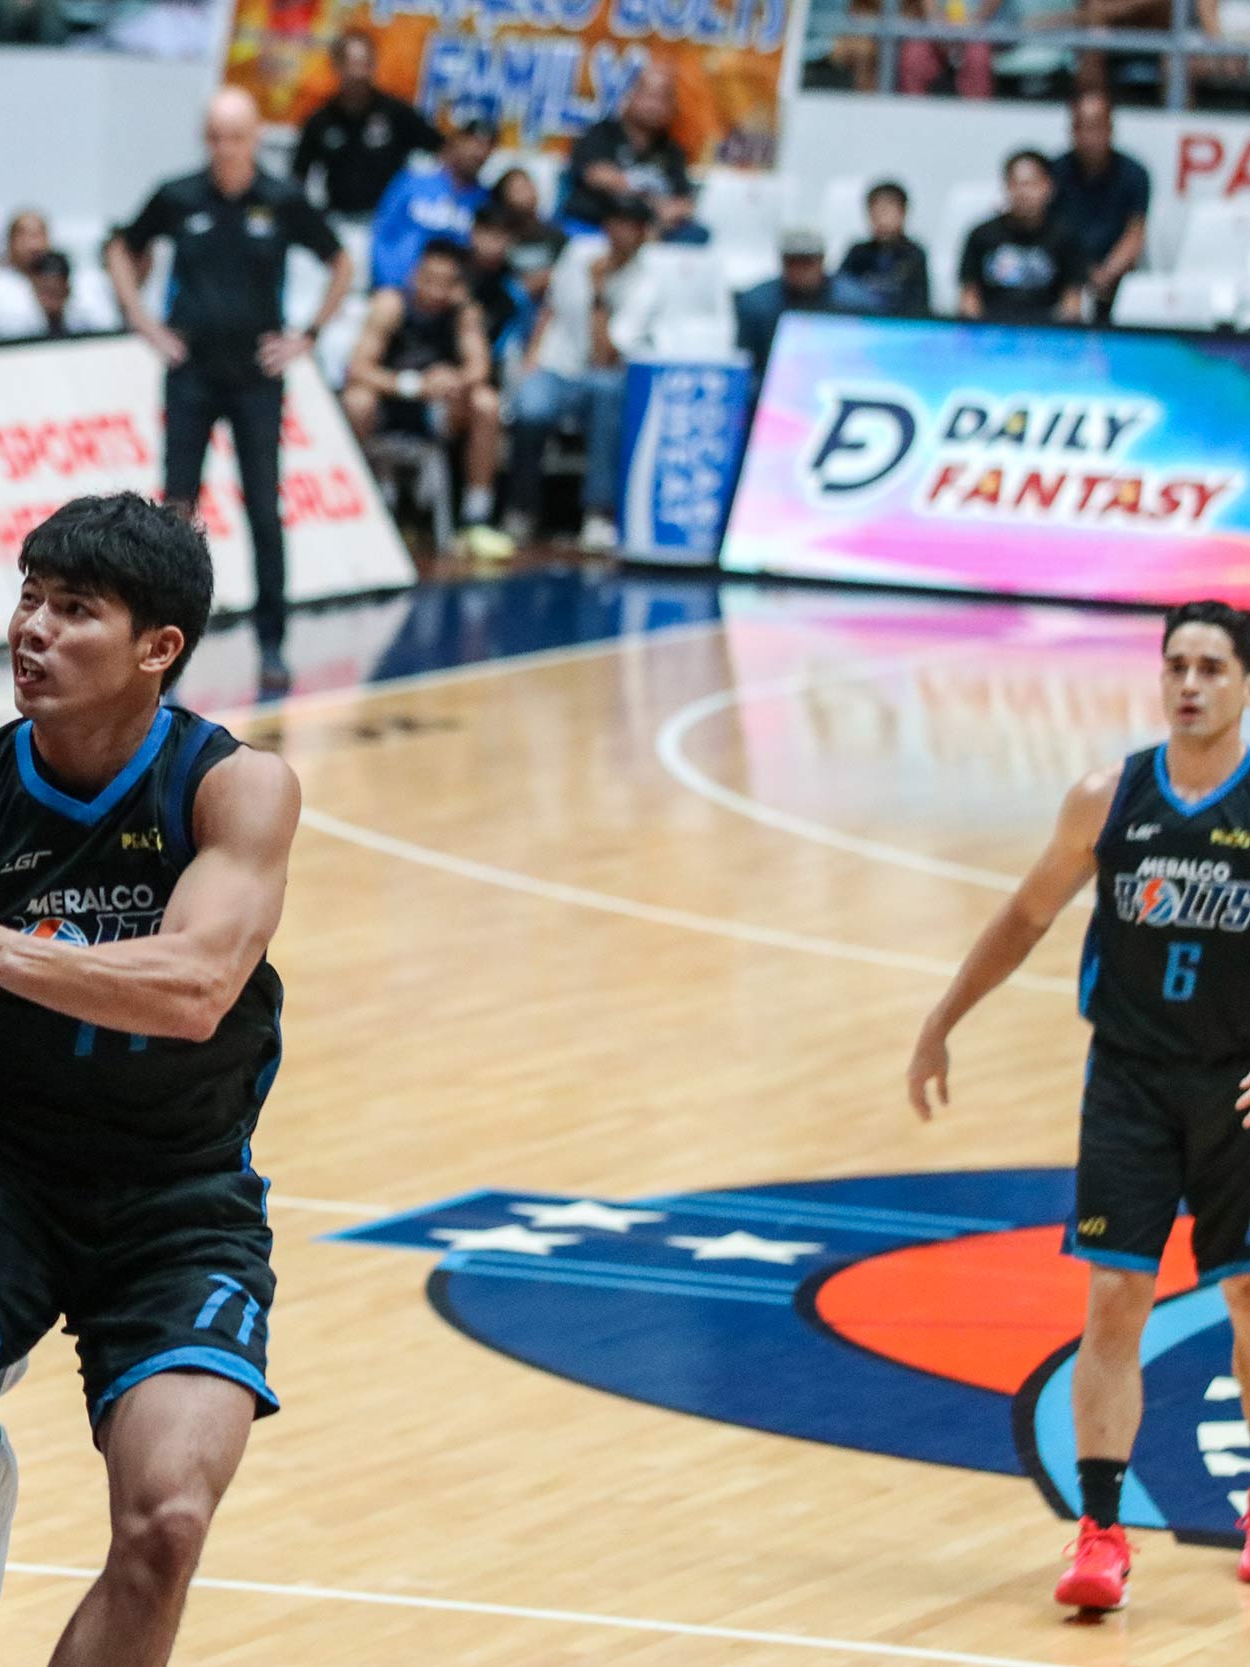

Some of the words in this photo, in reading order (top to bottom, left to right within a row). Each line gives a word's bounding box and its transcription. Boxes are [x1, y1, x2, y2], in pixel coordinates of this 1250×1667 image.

[942, 405, 1138, 449] DAILY
[928, 465, 1228, 519] FANTASY
[1136, 856, 1230, 883] MERALCO
[26, 884, 153, 915] MERALCO
[1162, 940, 1203, 1001] 6
[193, 1273, 260, 1346] 77
